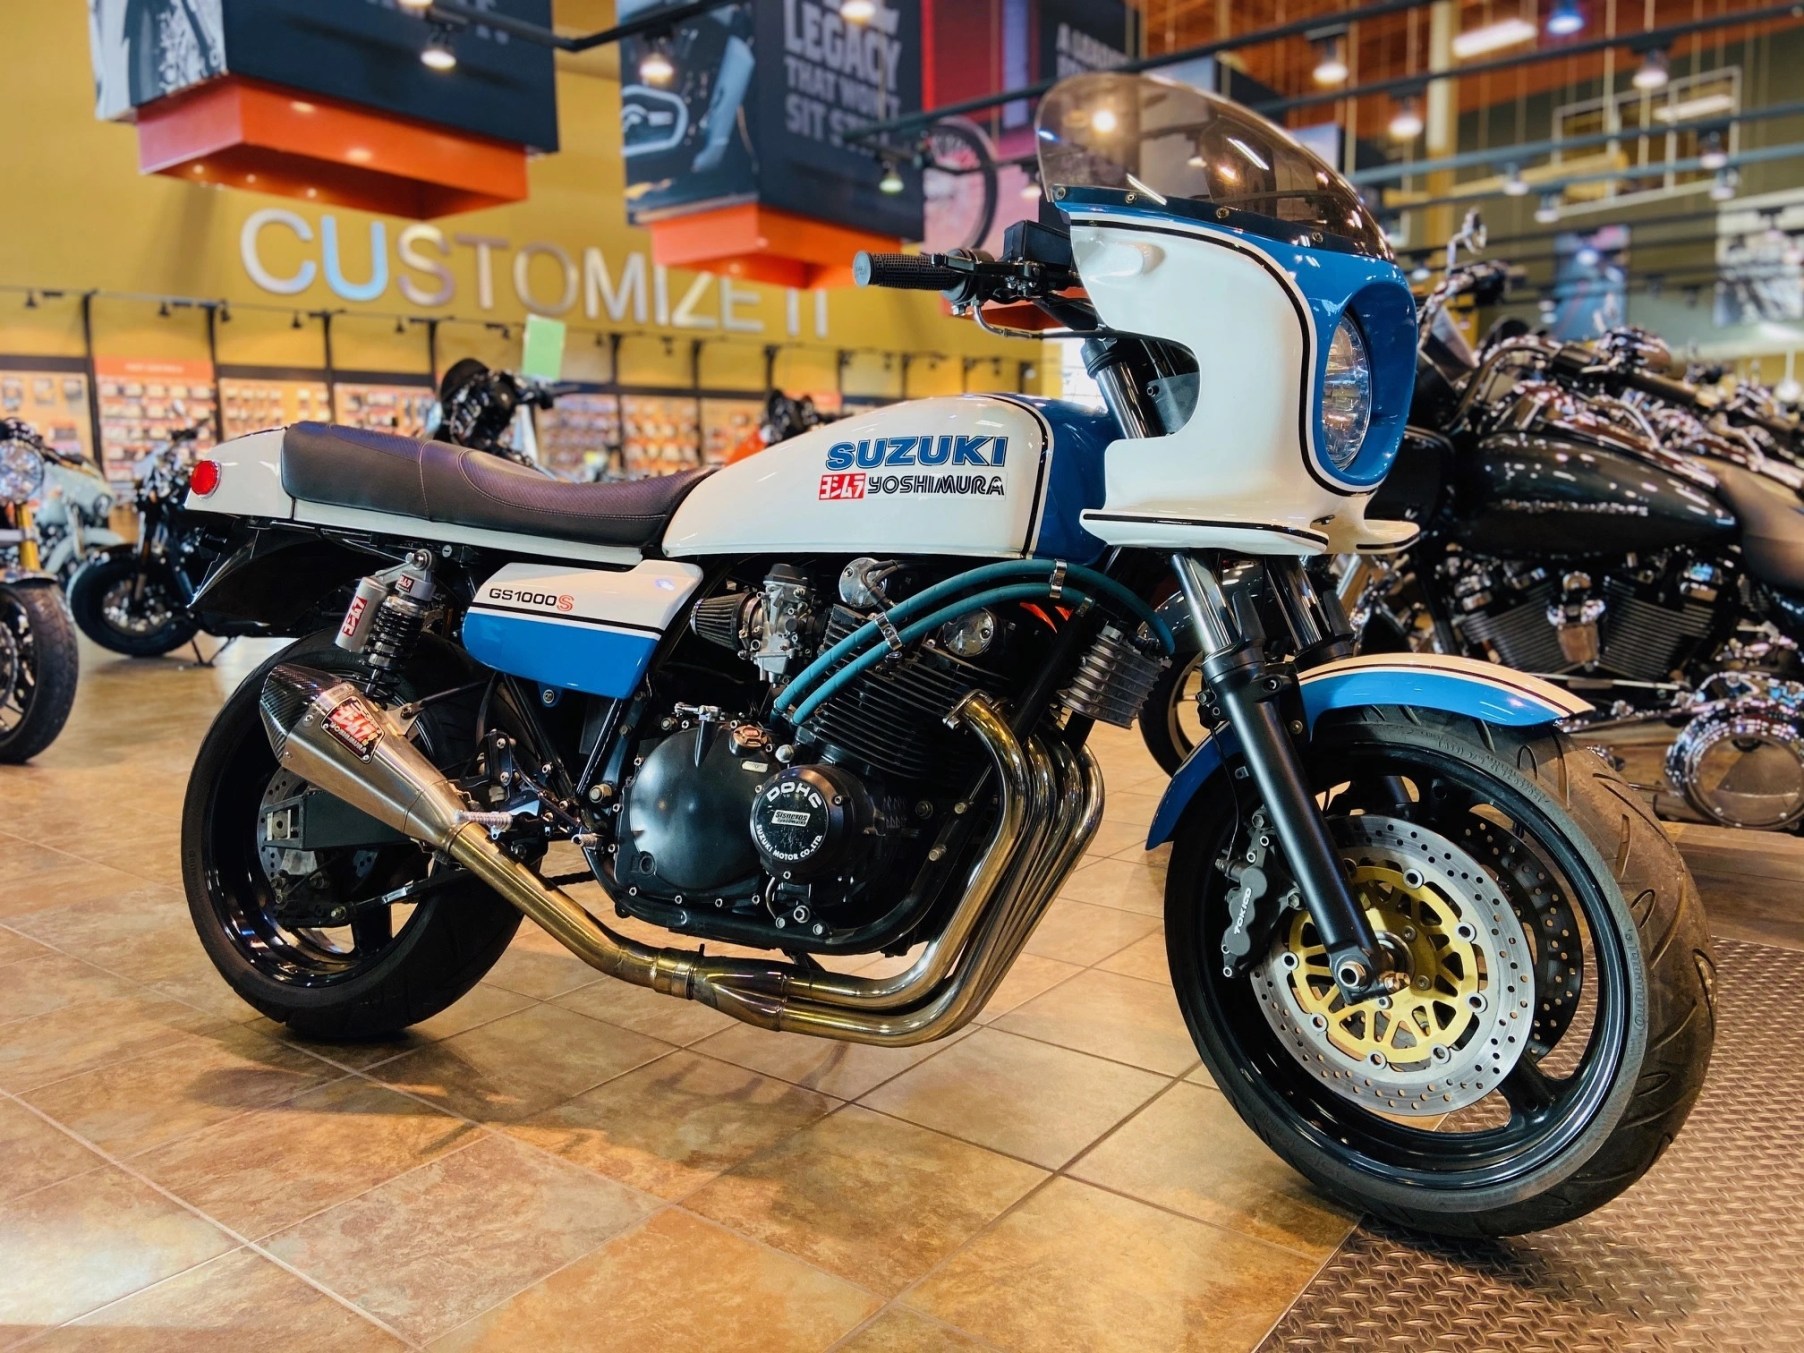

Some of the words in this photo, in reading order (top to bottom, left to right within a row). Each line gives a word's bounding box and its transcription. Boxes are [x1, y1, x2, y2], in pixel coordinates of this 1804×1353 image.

[784, 0, 901, 91] LEGACY
[784, 55, 837, 103] THAT
[785, 93, 827, 141] SIT
[241, 208, 764, 332] CUSTOMIZE
[825, 436, 1009, 471] SUZUKI
[867, 475, 1005, 496] YOSHIMURA
[489, 588, 575, 612] GS1000S
[766, 781, 823, 809] DOHC
[756, 824, 773, 852] SUZUKI
[772, 849, 799, 860] MOTOR
[1234, 887, 1252, 934] TOKICO
